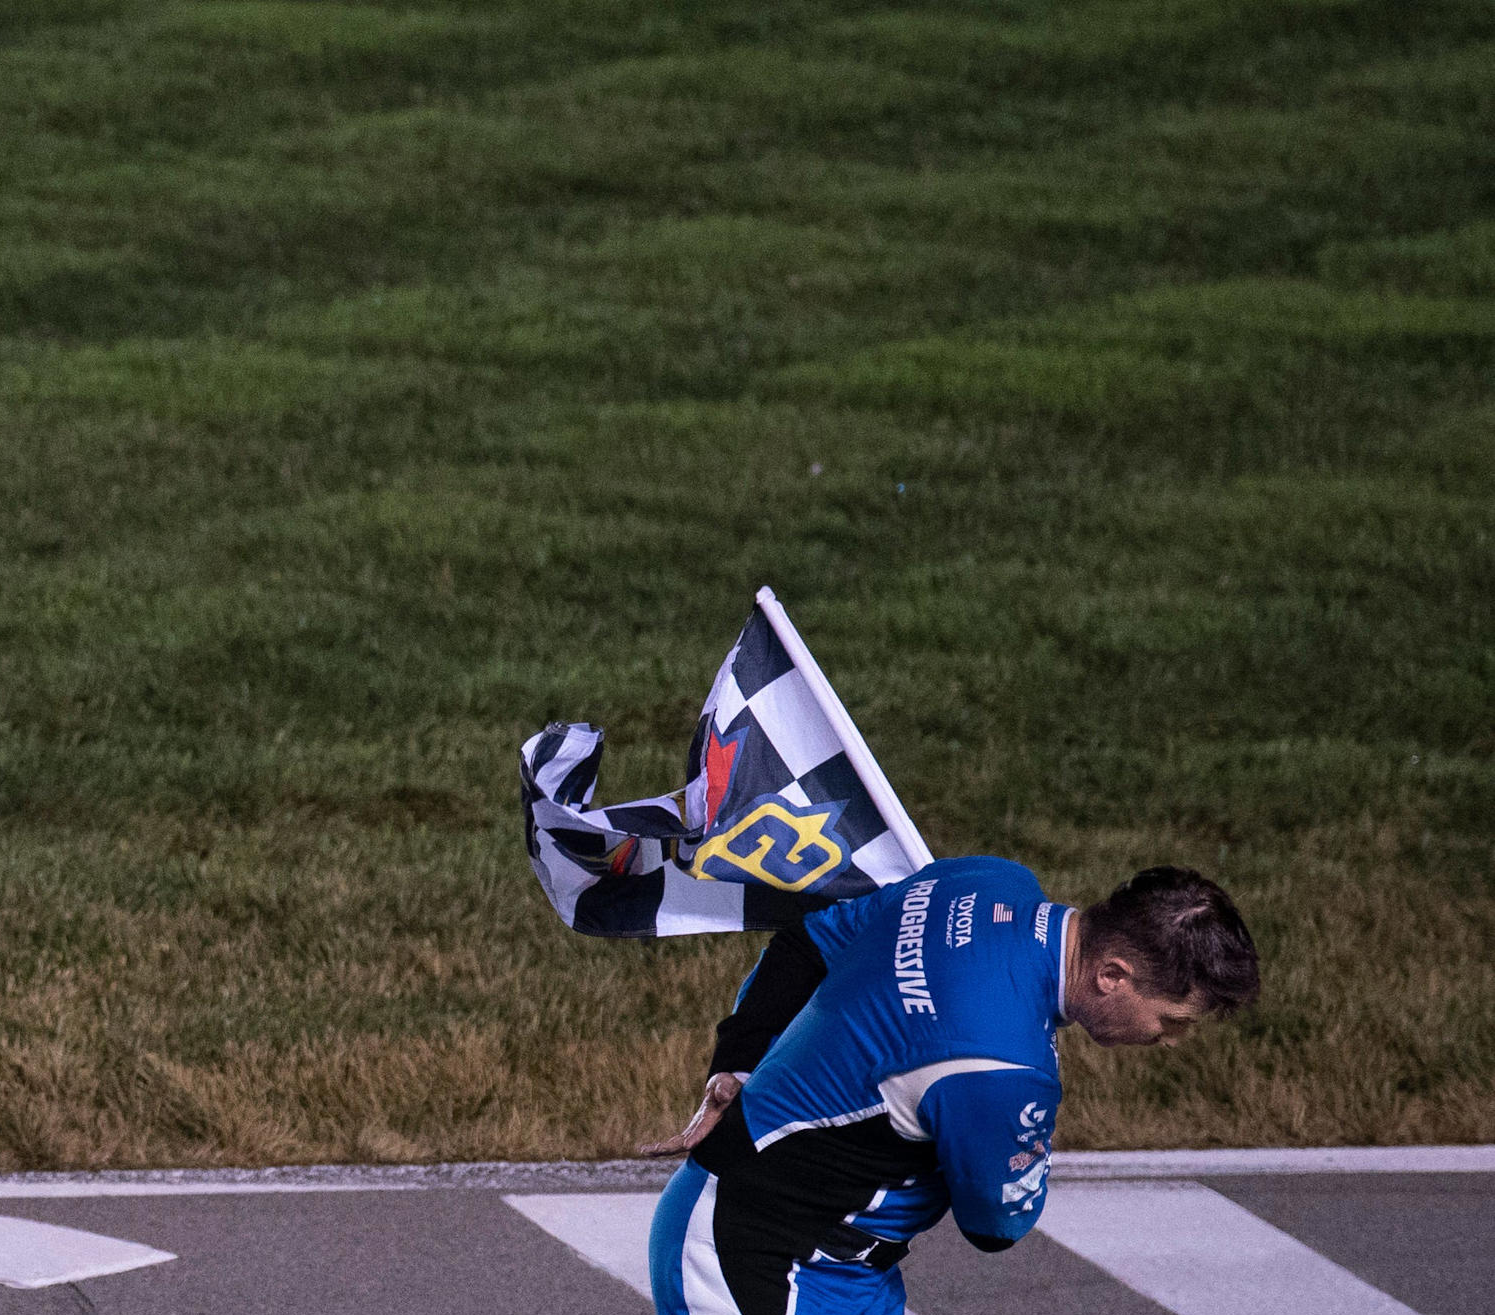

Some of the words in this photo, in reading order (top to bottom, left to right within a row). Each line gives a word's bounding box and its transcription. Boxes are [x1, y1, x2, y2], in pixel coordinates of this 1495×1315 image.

[894, 878, 939, 1015] PROGRESSIVE
[945, 897, 959, 949] RACING
[955, 892, 977, 948] TOYOTA
